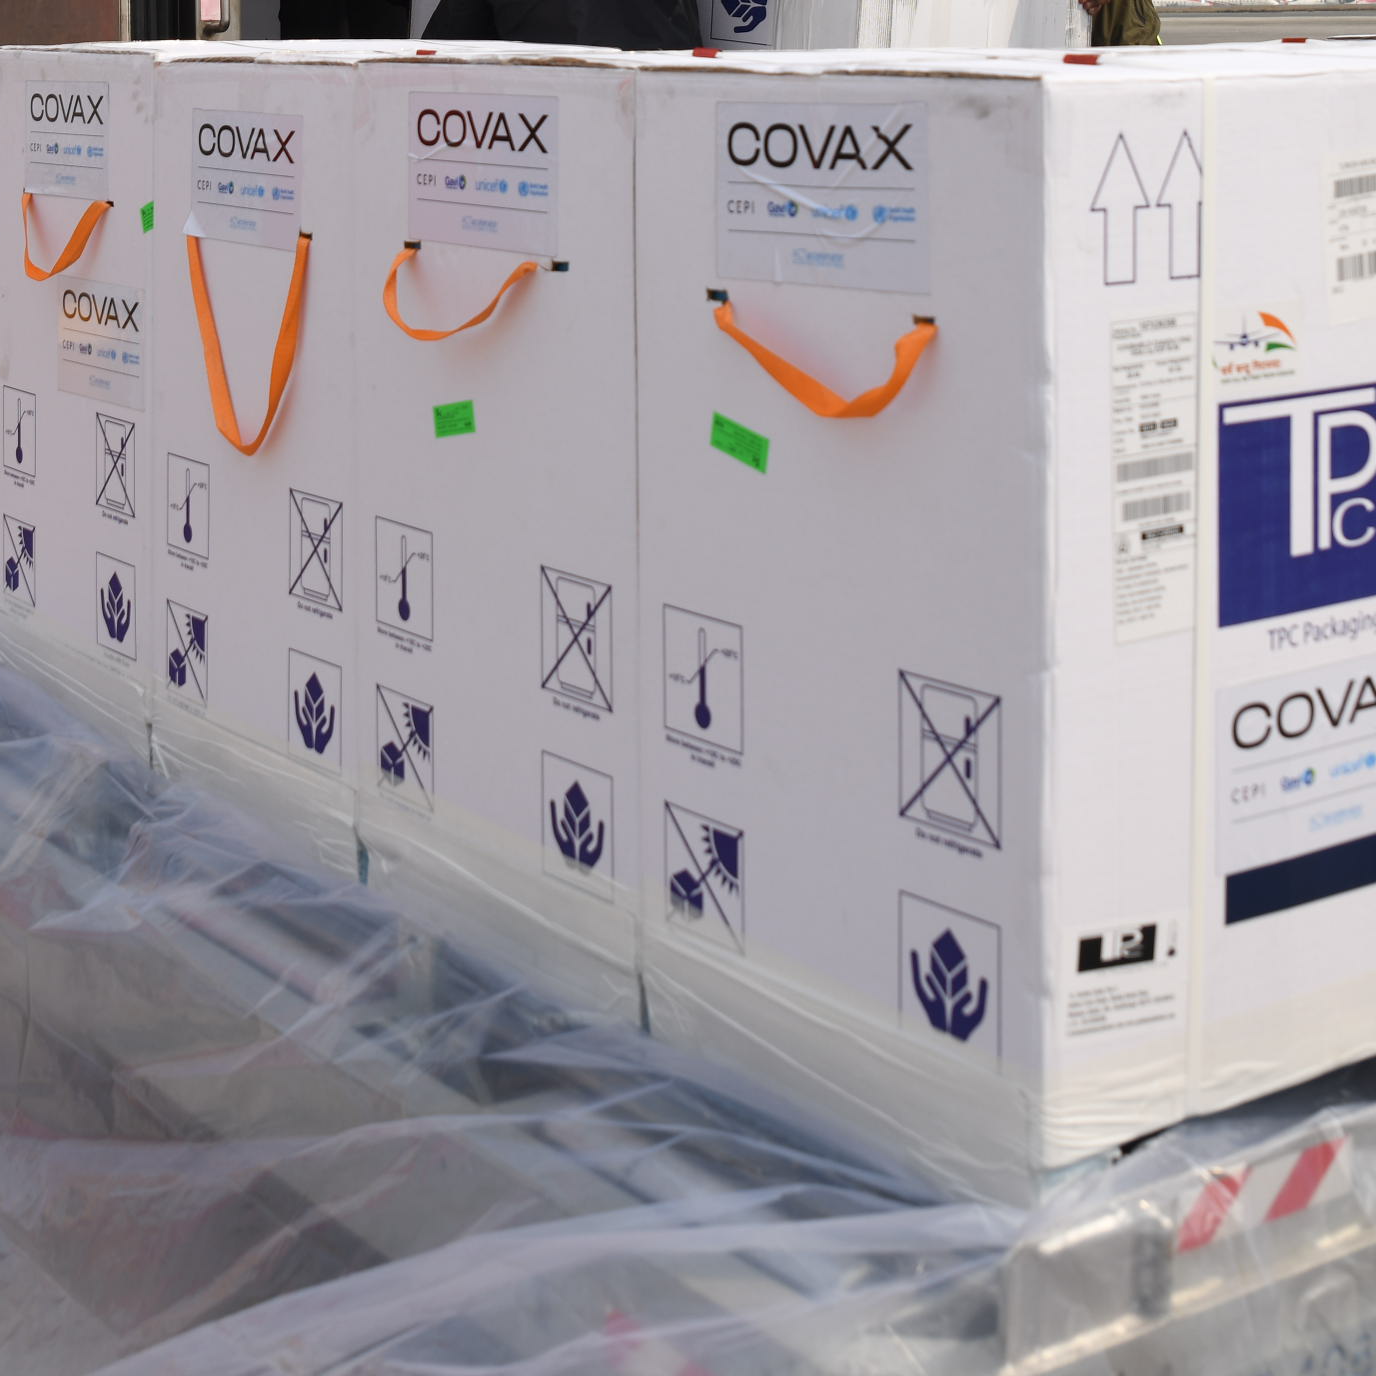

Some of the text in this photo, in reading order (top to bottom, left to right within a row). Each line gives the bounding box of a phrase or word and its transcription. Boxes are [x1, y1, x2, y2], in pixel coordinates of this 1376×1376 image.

[30, 93, 104, 125] COVAX
[198, 123, 296, 164] COVAX
[417, 109, 549, 154] COVAX
[727, 122, 914, 171] COVAX
[417, 173, 437, 188] CEPI
[727, 200, 755, 214] CEPI
[62, 289, 139, 333] COVAX
[1268, 623, 1299, 651] TPC
[1230, 783, 1267, 805] CEPI
